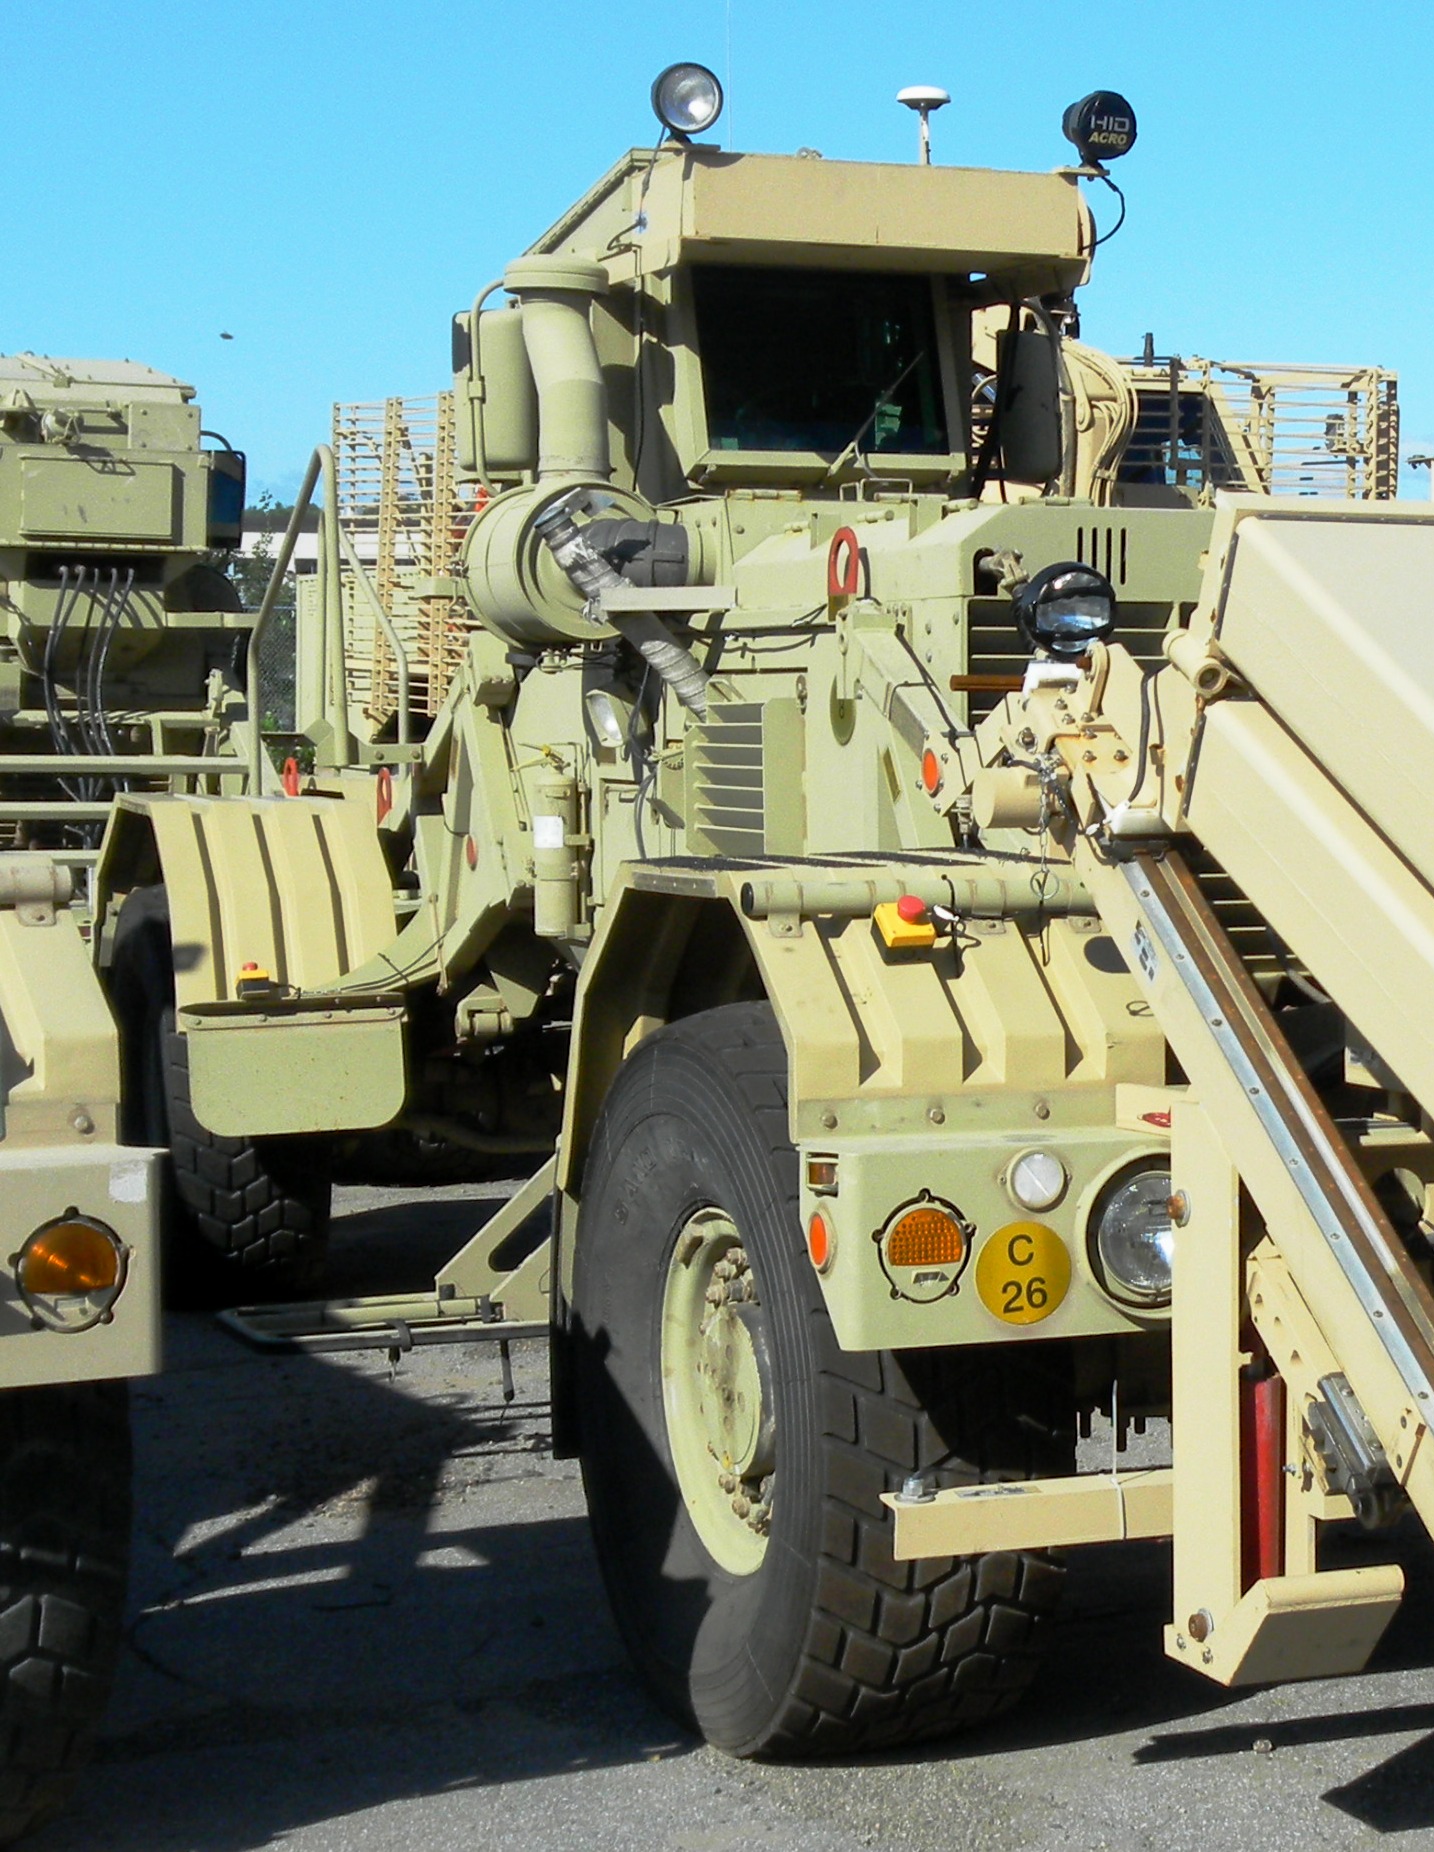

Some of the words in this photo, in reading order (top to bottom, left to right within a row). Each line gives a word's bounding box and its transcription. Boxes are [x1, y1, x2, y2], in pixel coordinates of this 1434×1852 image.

[1090, 114, 1130, 132] HID
[1088, 131, 1127, 145] ACRO
[1007, 1234, 1034, 1267] C
[1001, 1276, 1048, 1314] 26
